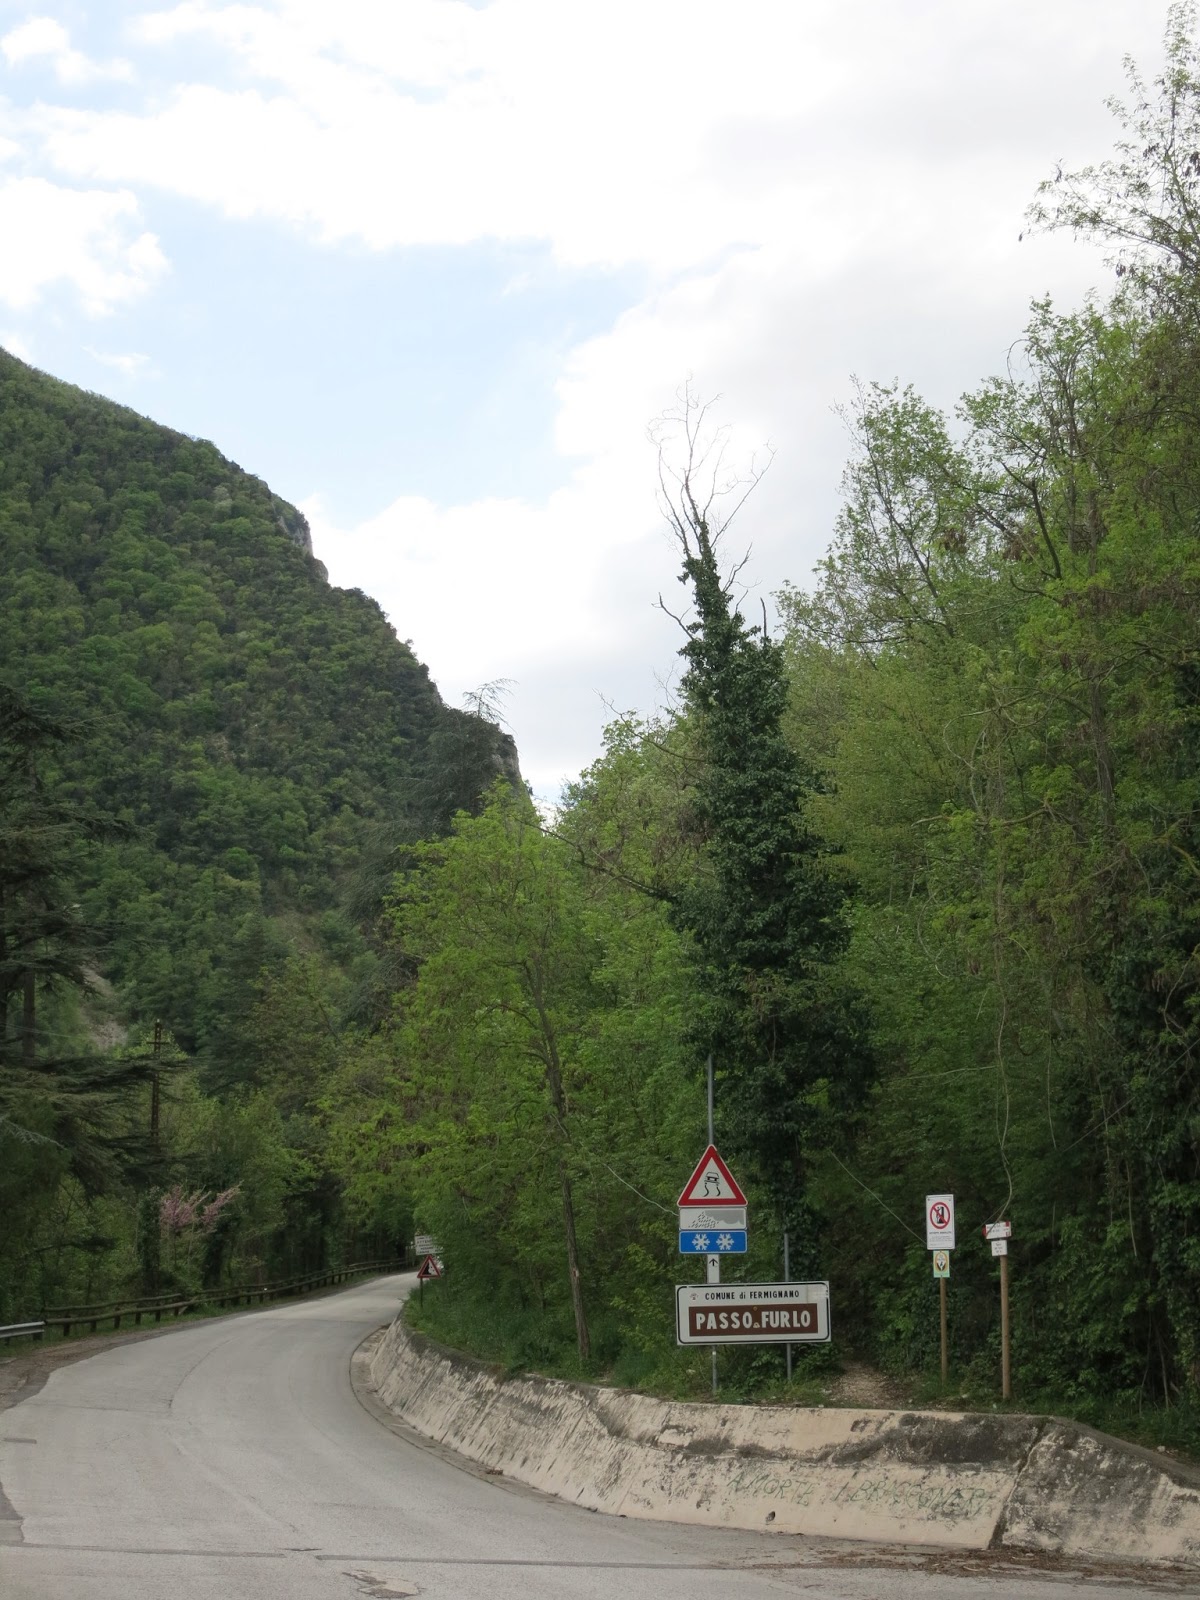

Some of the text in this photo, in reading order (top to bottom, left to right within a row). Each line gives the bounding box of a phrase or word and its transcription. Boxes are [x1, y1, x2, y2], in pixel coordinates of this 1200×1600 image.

[704, 1289, 800, 1301] COMUNE di FERMIGNANO
[695, 1310, 811, 1330] PASSO FURLO
[746, 1473, 820, 1507] MORTE
